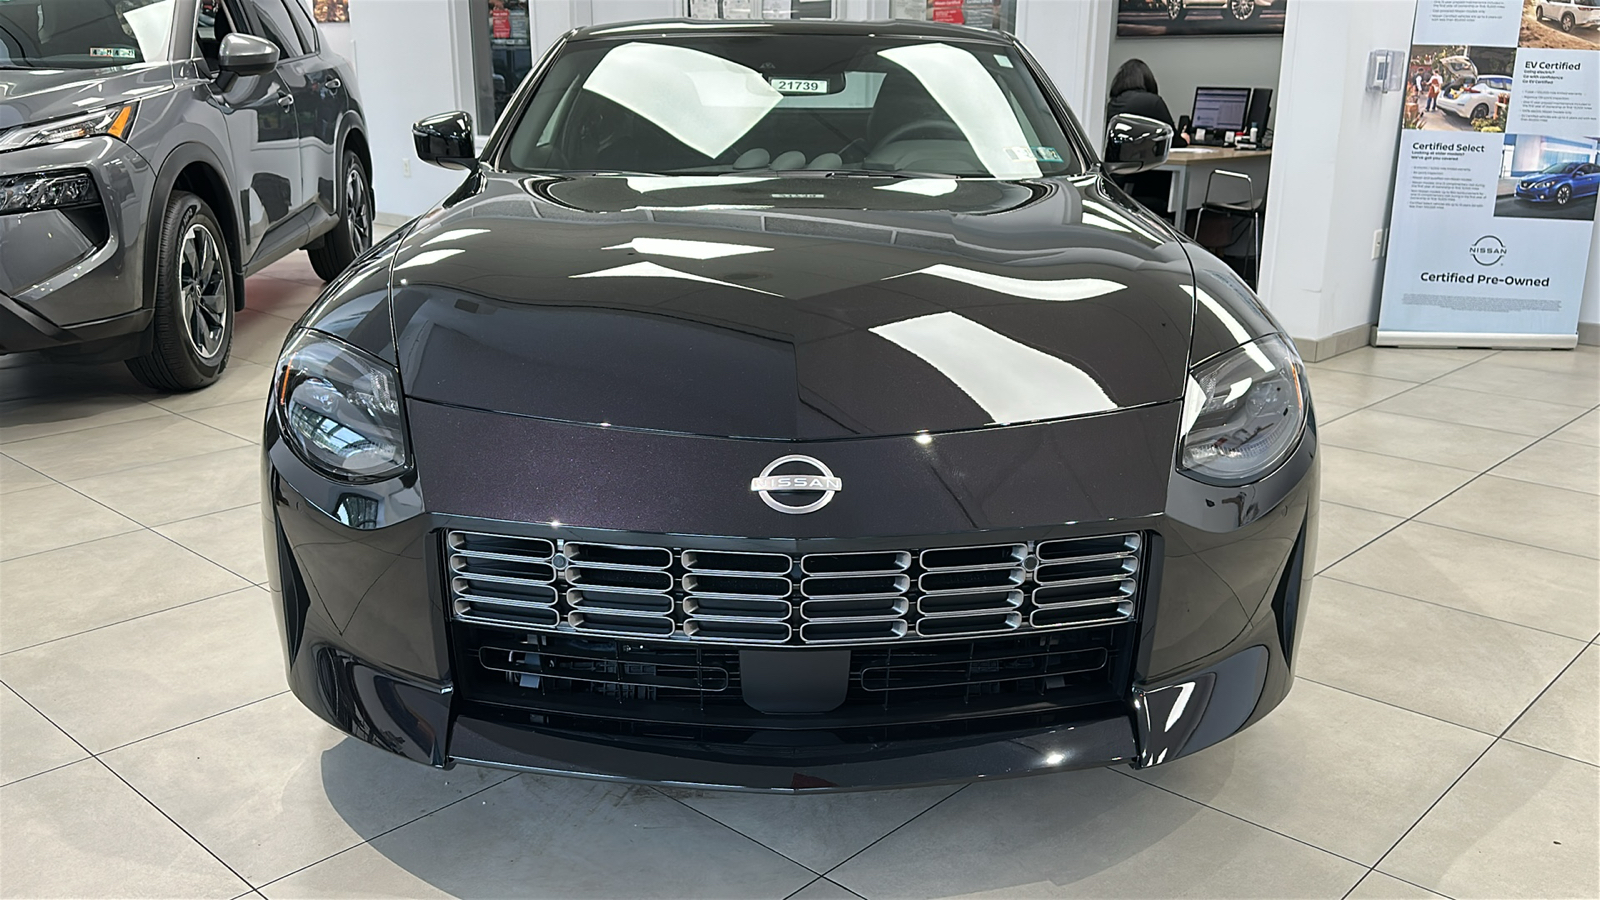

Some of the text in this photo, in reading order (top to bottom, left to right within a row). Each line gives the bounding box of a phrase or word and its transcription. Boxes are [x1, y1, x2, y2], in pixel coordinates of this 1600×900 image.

[1525, 61, 1581, 70] EV Certified
[778, 81, 819, 91] 21739
[1412, 142, 1485, 152] Certified Select
[1469, 247, 1507, 255] NISSAN
[1420, 272, 1550, 287] Certified Pre-Owned
[754, 477, 840, 489] NISSAN
